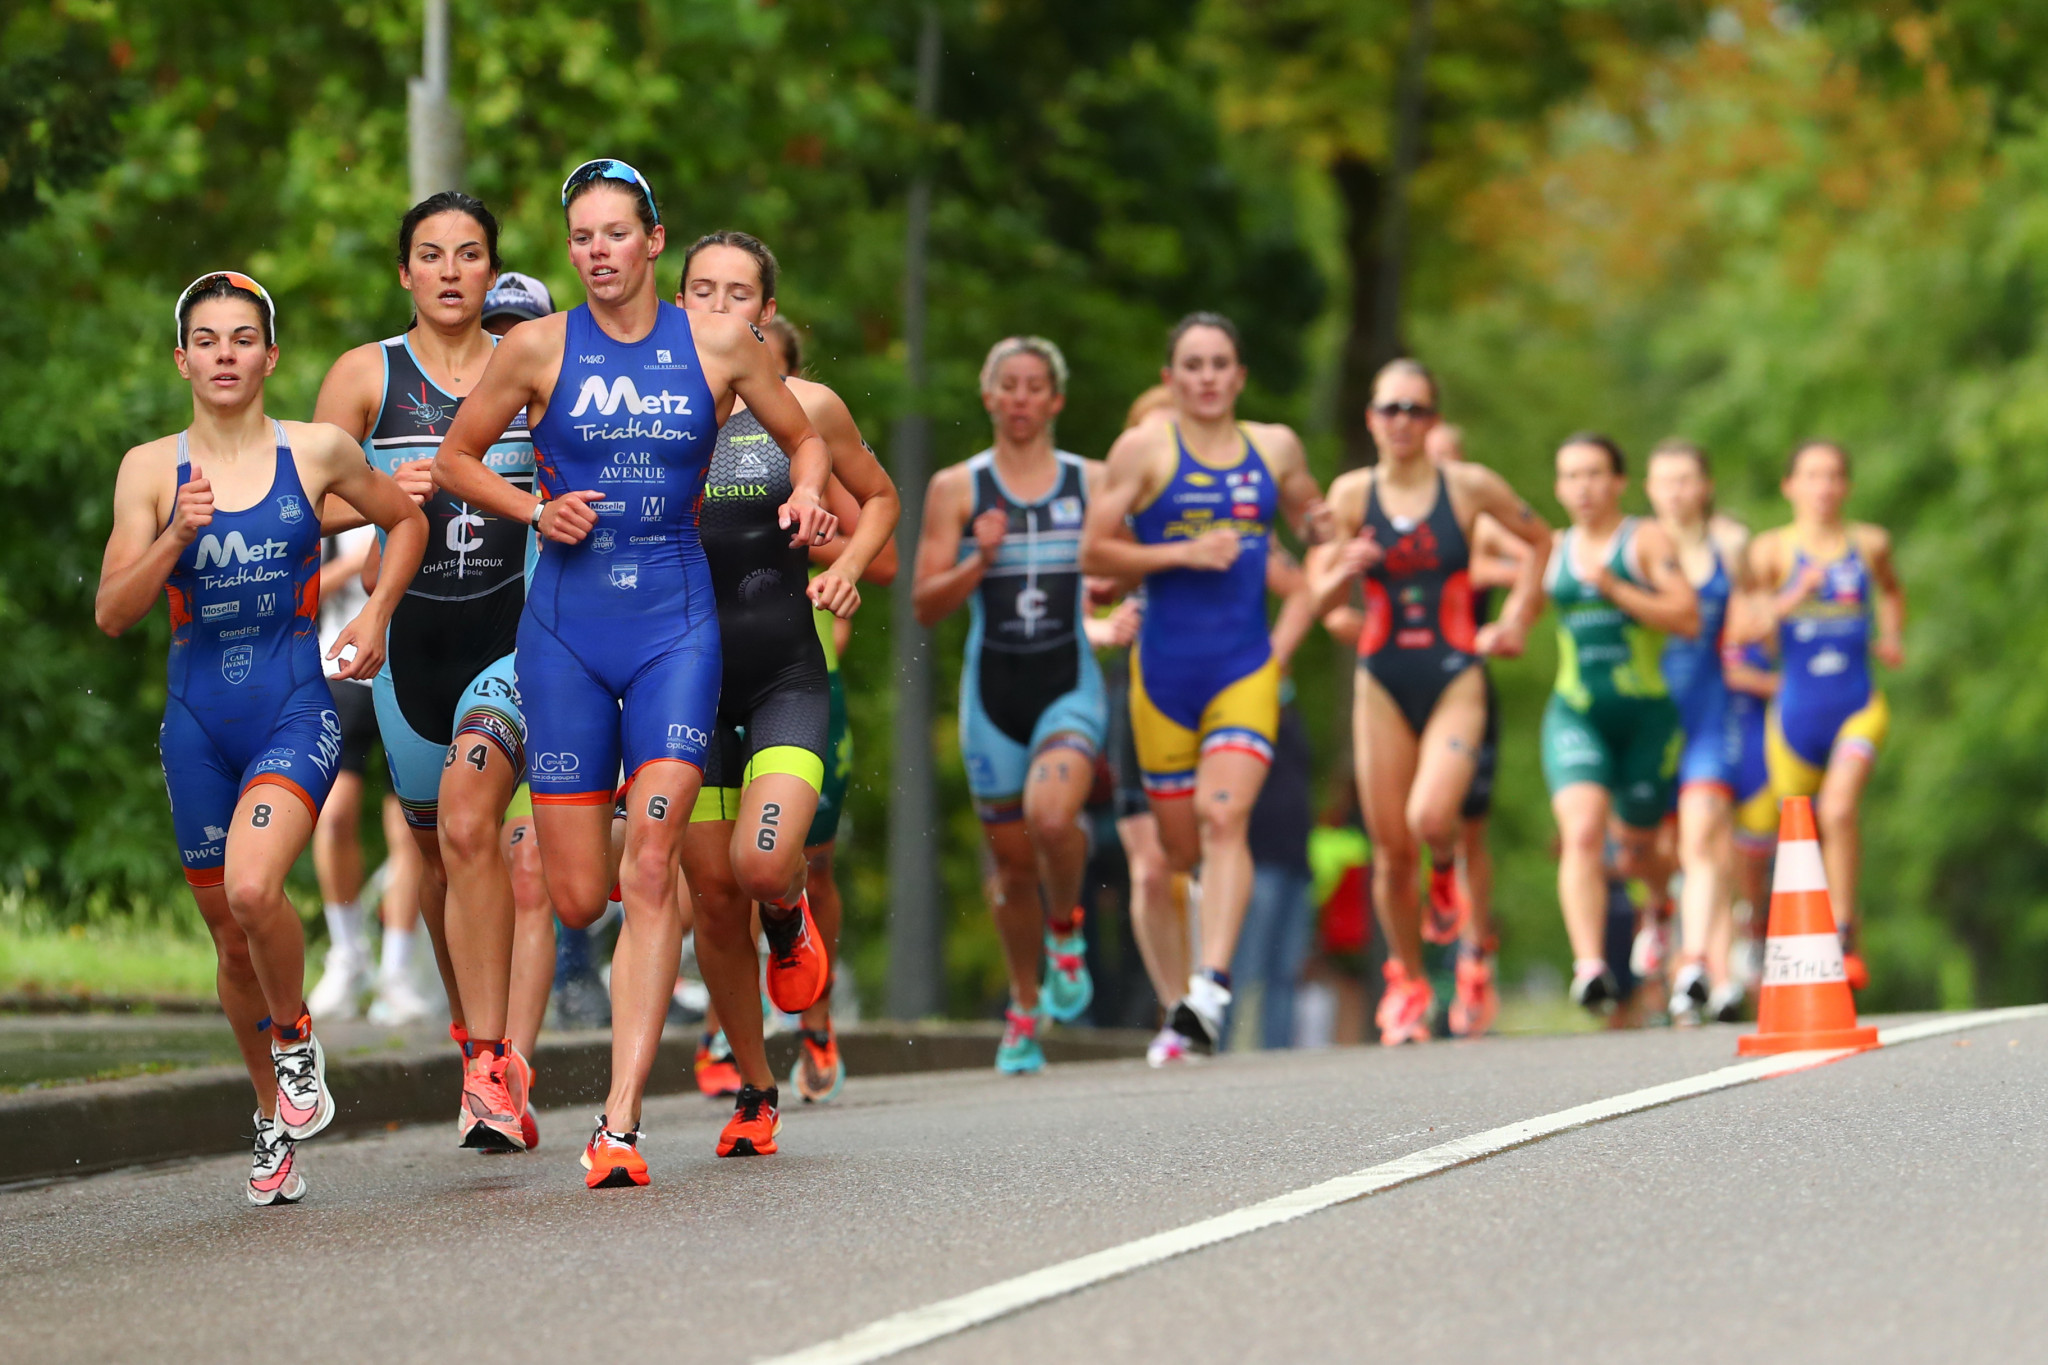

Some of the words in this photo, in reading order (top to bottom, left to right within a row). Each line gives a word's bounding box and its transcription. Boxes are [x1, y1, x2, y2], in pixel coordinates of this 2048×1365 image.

[568, 375, 692, 417] Metz
[573, 417, 697, 441] Triathlon
[613, 452, 651, 465] CAR
[599, 466, 665, 479] AVENUE
[704, 483, 768, 498] eaux
[591, 502, 624, 510] Moselle
[193, 530, 288, 570] Metz
[199, 566, 288, 590] Triathlon
[203, 603, 238, 615] Moselle
[224, 659, 250, 669] AVENUE
[230, 654, 245, 662] CAR
[531, 751, 580, 773] JCD
[647, 794, 669, 820] 6
[251, 803, 273, 829] 8
[183, 846, 223, 863] pwc
